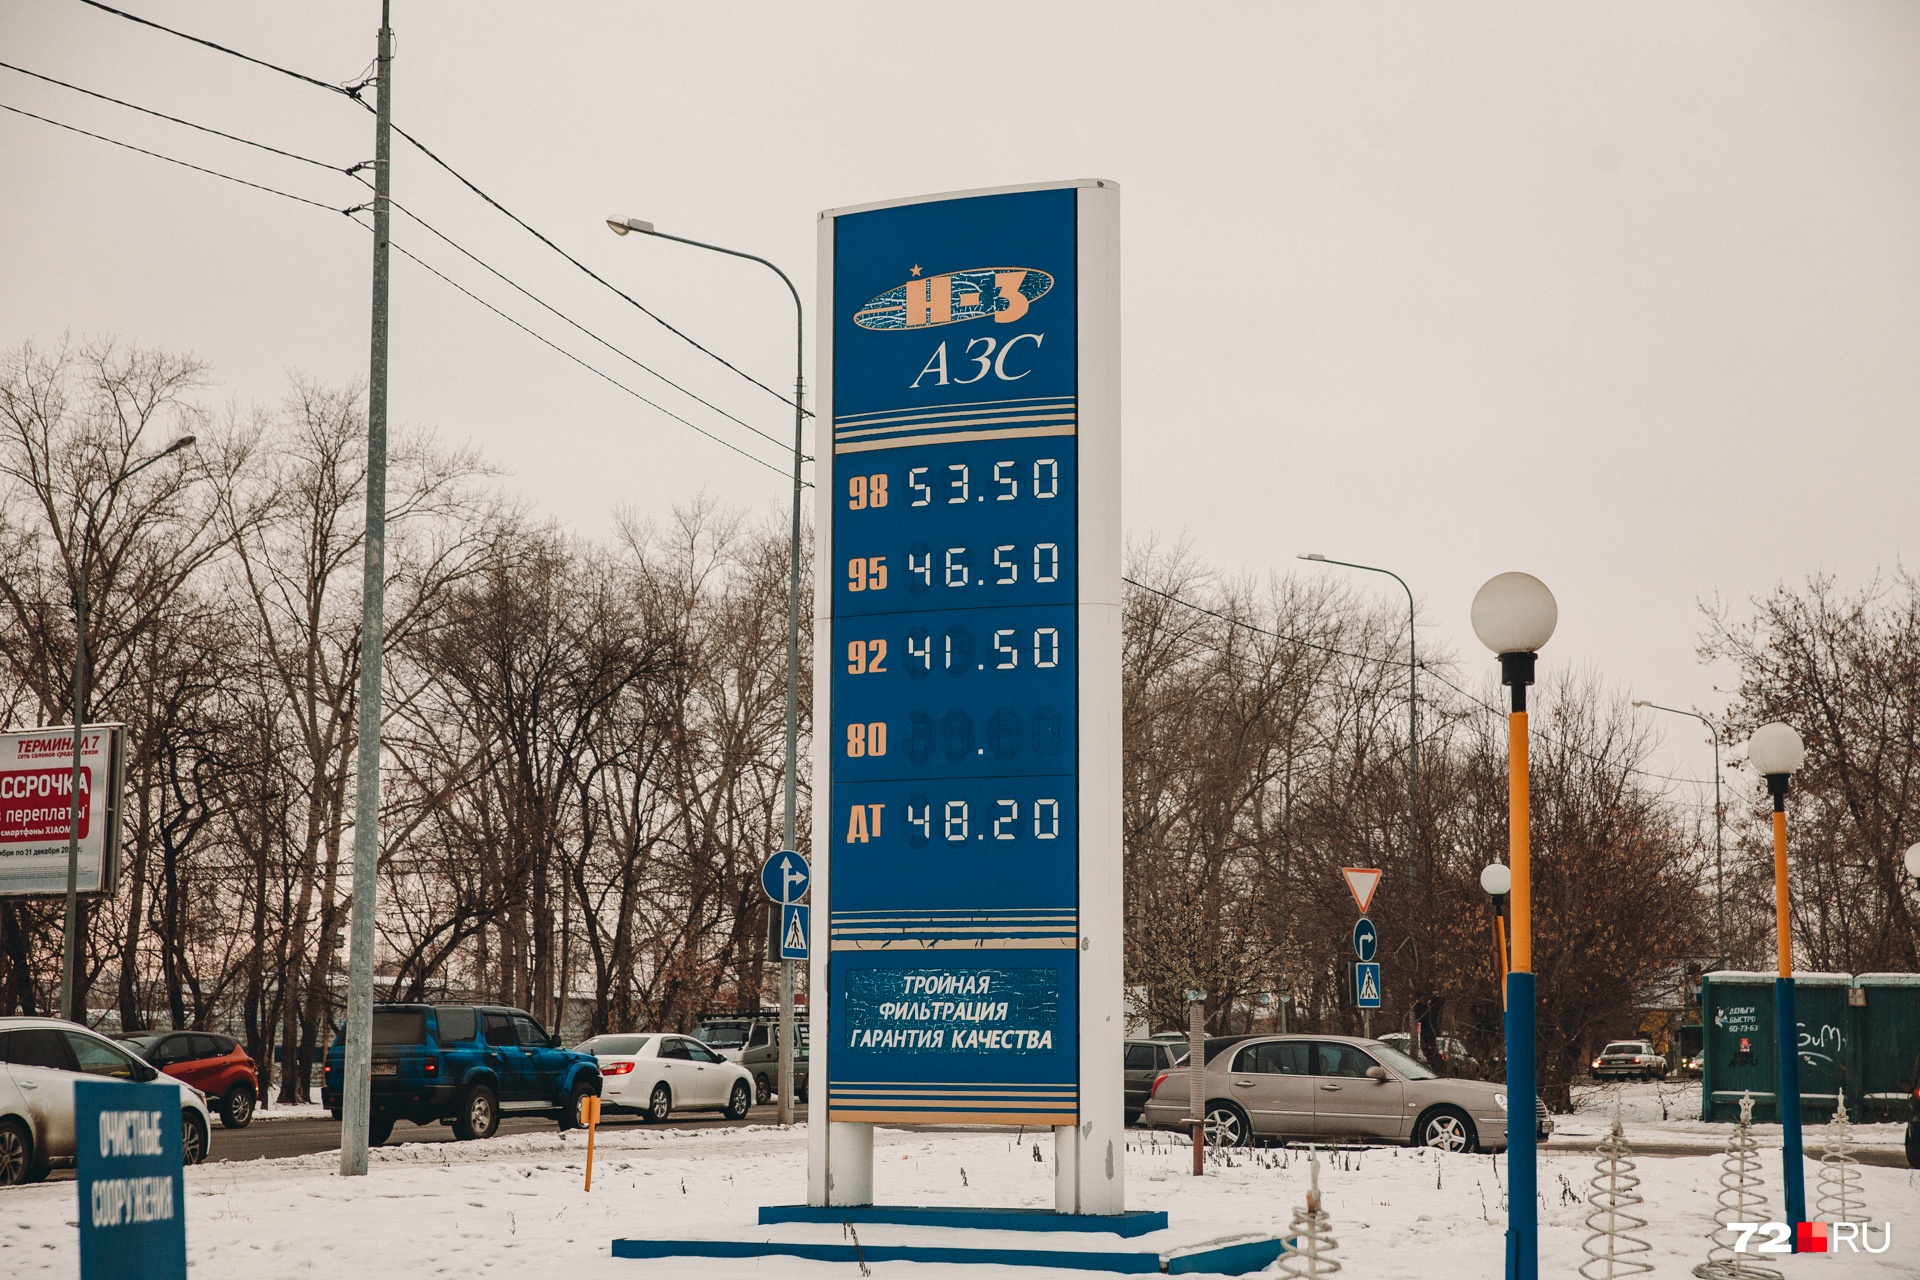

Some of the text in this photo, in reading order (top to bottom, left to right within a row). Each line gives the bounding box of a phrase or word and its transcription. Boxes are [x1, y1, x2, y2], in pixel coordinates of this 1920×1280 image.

[909, 333, 1045, 389] АЗС
[849, 458, 1058, 511] 98 53.50
[848, 542, 1058, 592] 95 46.50
[847, 627, 1059, 675] 92 41.50
[92, 735, 100, 749] 7
[846, 722, 887, 758] 80
[0, 772, 89, 799] ССРОЧКА
[907, 798, 1059, 841] 48.20
[904, 972, 990, 995] ТРОЙНАЯ
[879, 1001, 1008, 1023] ФИЛЬТРАЦИЯ
[851, 1029, 1053, 1049] ГАРАНТИЯ КАЧЕСТВА
[99, 1111, 163, 1157] ОЧИСТНЫЕ
[92, 1175, 174, 1228] СООРУЖЕНИЯ
